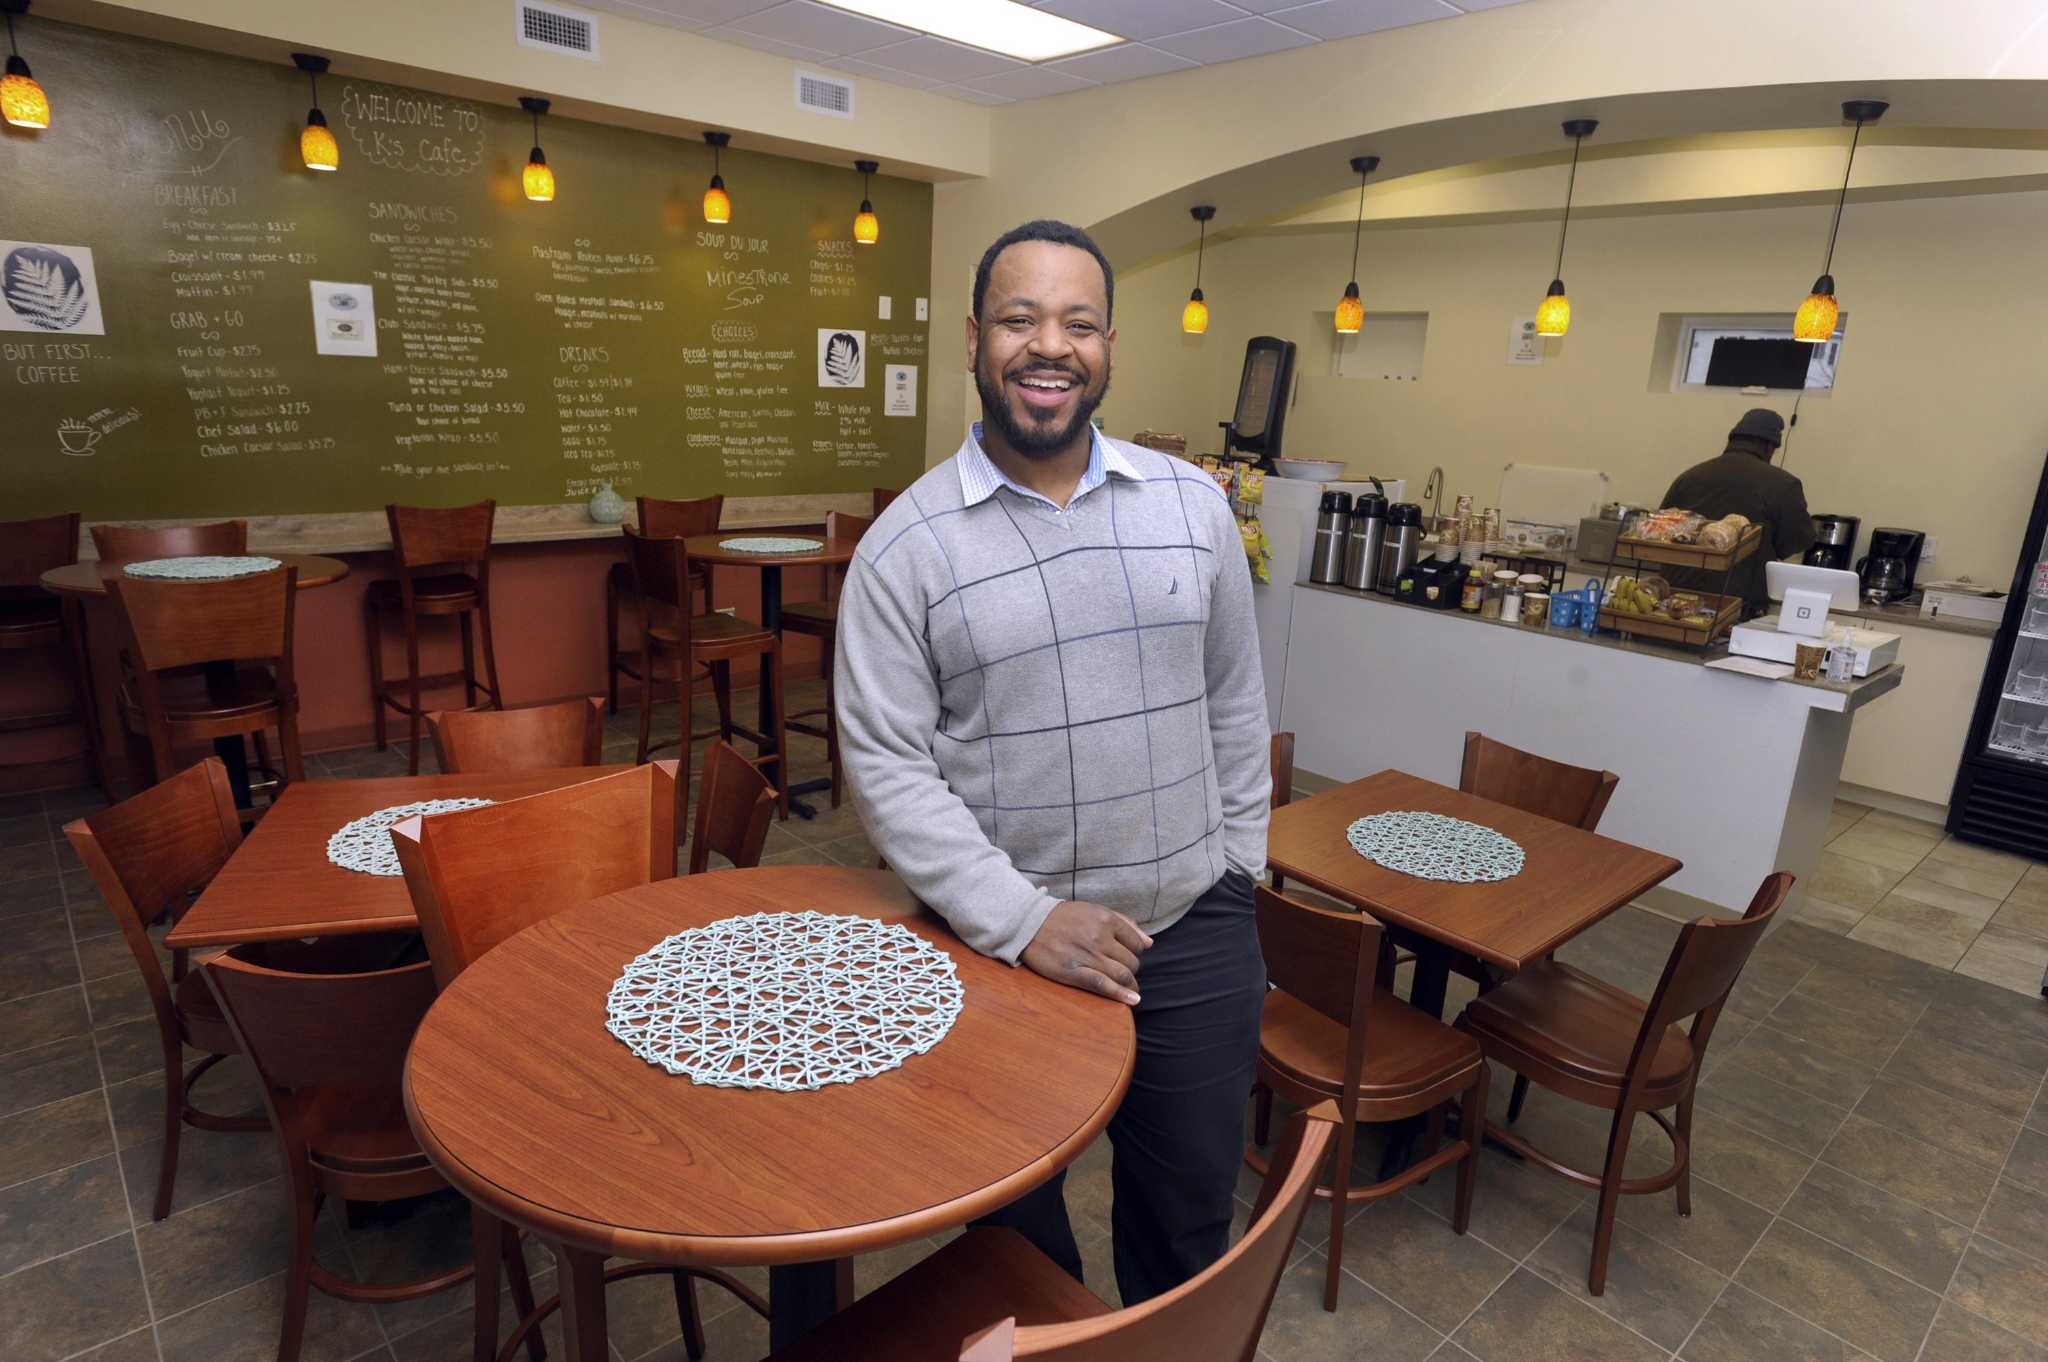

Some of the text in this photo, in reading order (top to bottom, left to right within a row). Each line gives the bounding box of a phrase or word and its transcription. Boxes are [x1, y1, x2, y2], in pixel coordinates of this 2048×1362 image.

[355, 93, 478, 131] WELCOME TO
[154, 184, 237, 206] BREAKFAST
[369, 201, 458, 224] SANDWICHES
[696, 231, 769, 253] SOUP DU JOUR
[167, 249, 199, 268] Bagel
[170, 310, 208, 329] GRAB
[224, 309, 243, 329] GO
[2, 343, 35, 361] BUT
[559, 346, 609, 362] DRINKS
[16, 365, 81, 385] COFFEE
